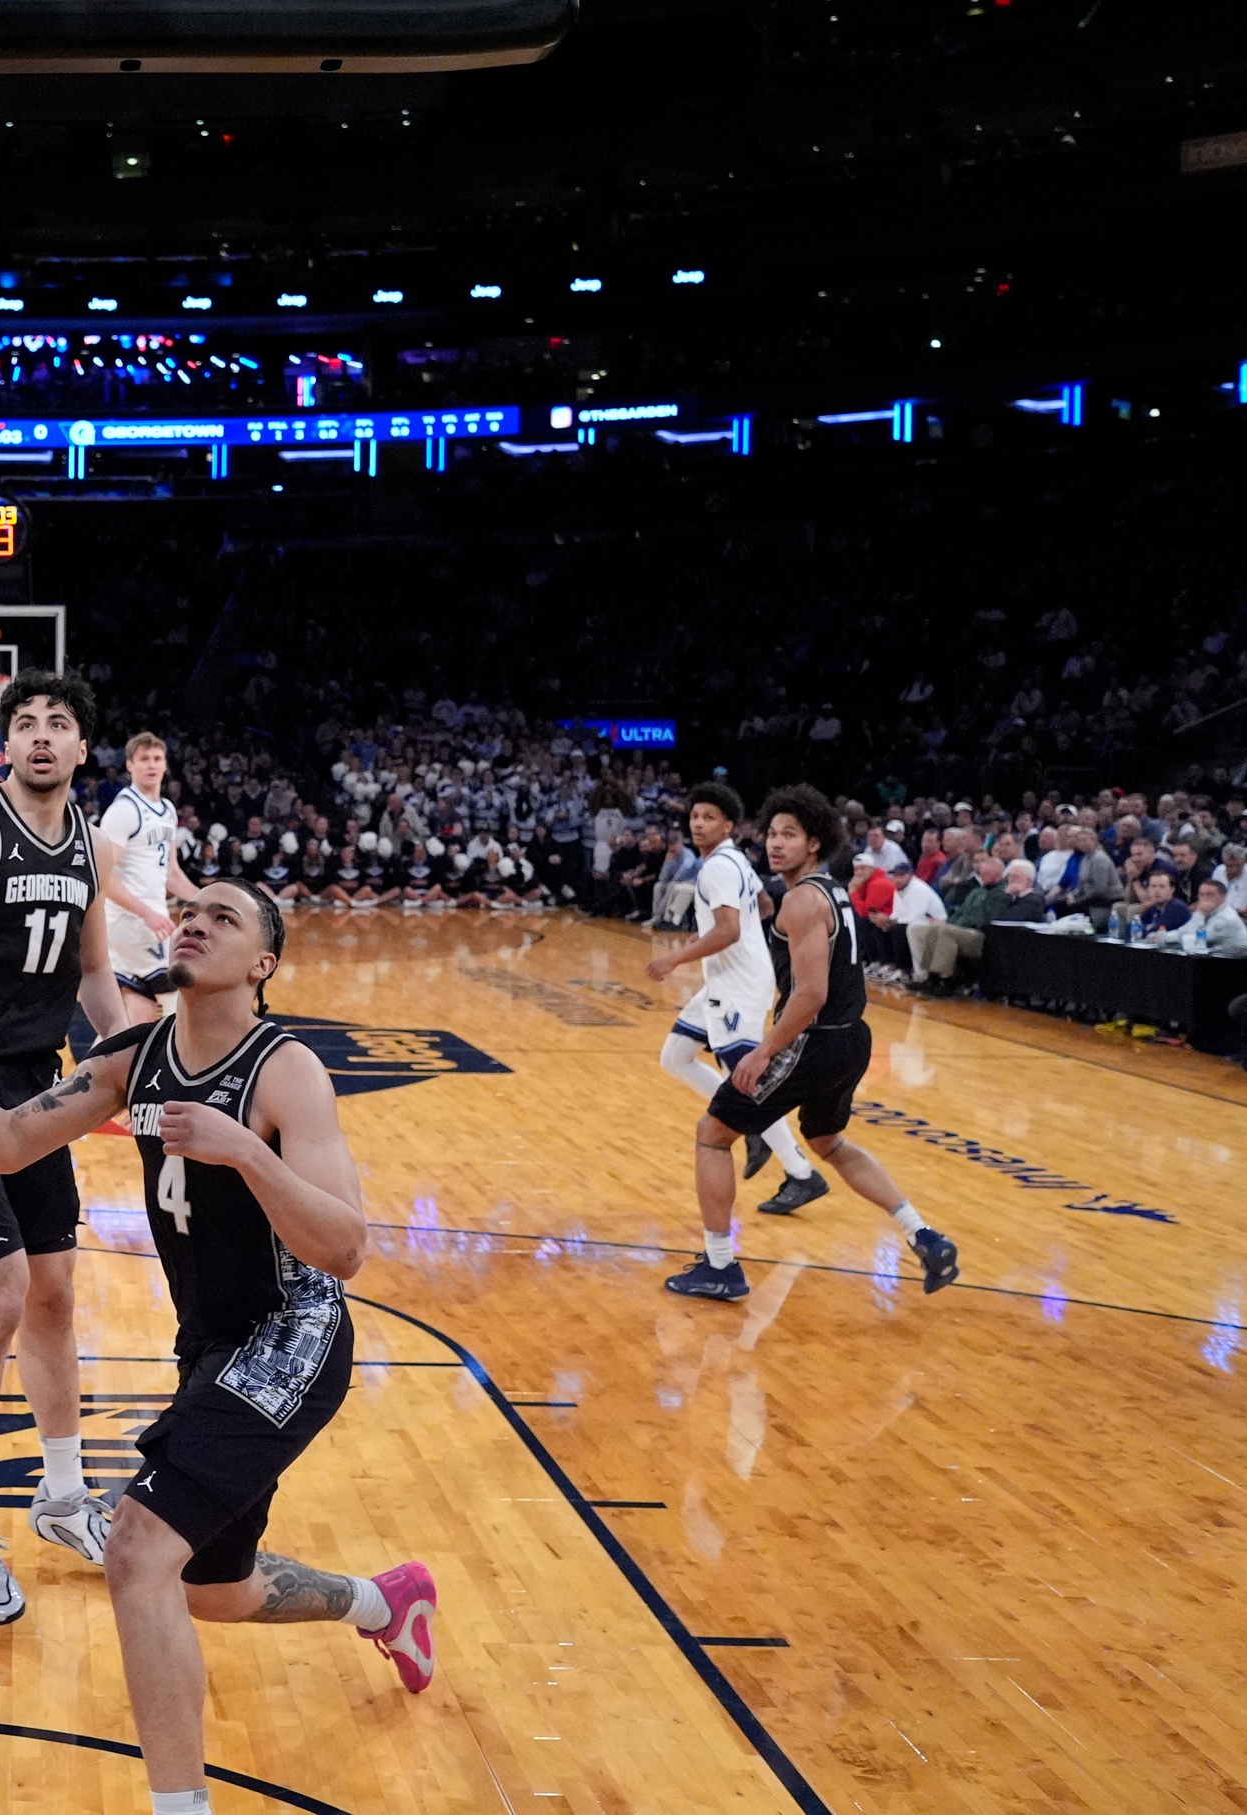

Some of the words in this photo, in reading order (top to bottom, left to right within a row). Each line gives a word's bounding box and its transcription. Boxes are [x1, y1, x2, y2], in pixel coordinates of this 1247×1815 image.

[33, 423, 48, 440] 0
[102, 424, 225, 439] GEORGETOWN
[621, 727, 674, 741] ULTRA
[5, 874, 89, 911] GEORGETOWN
[22, 908, 70, 974] 11
[157, 1154, 192, 1236] 4
